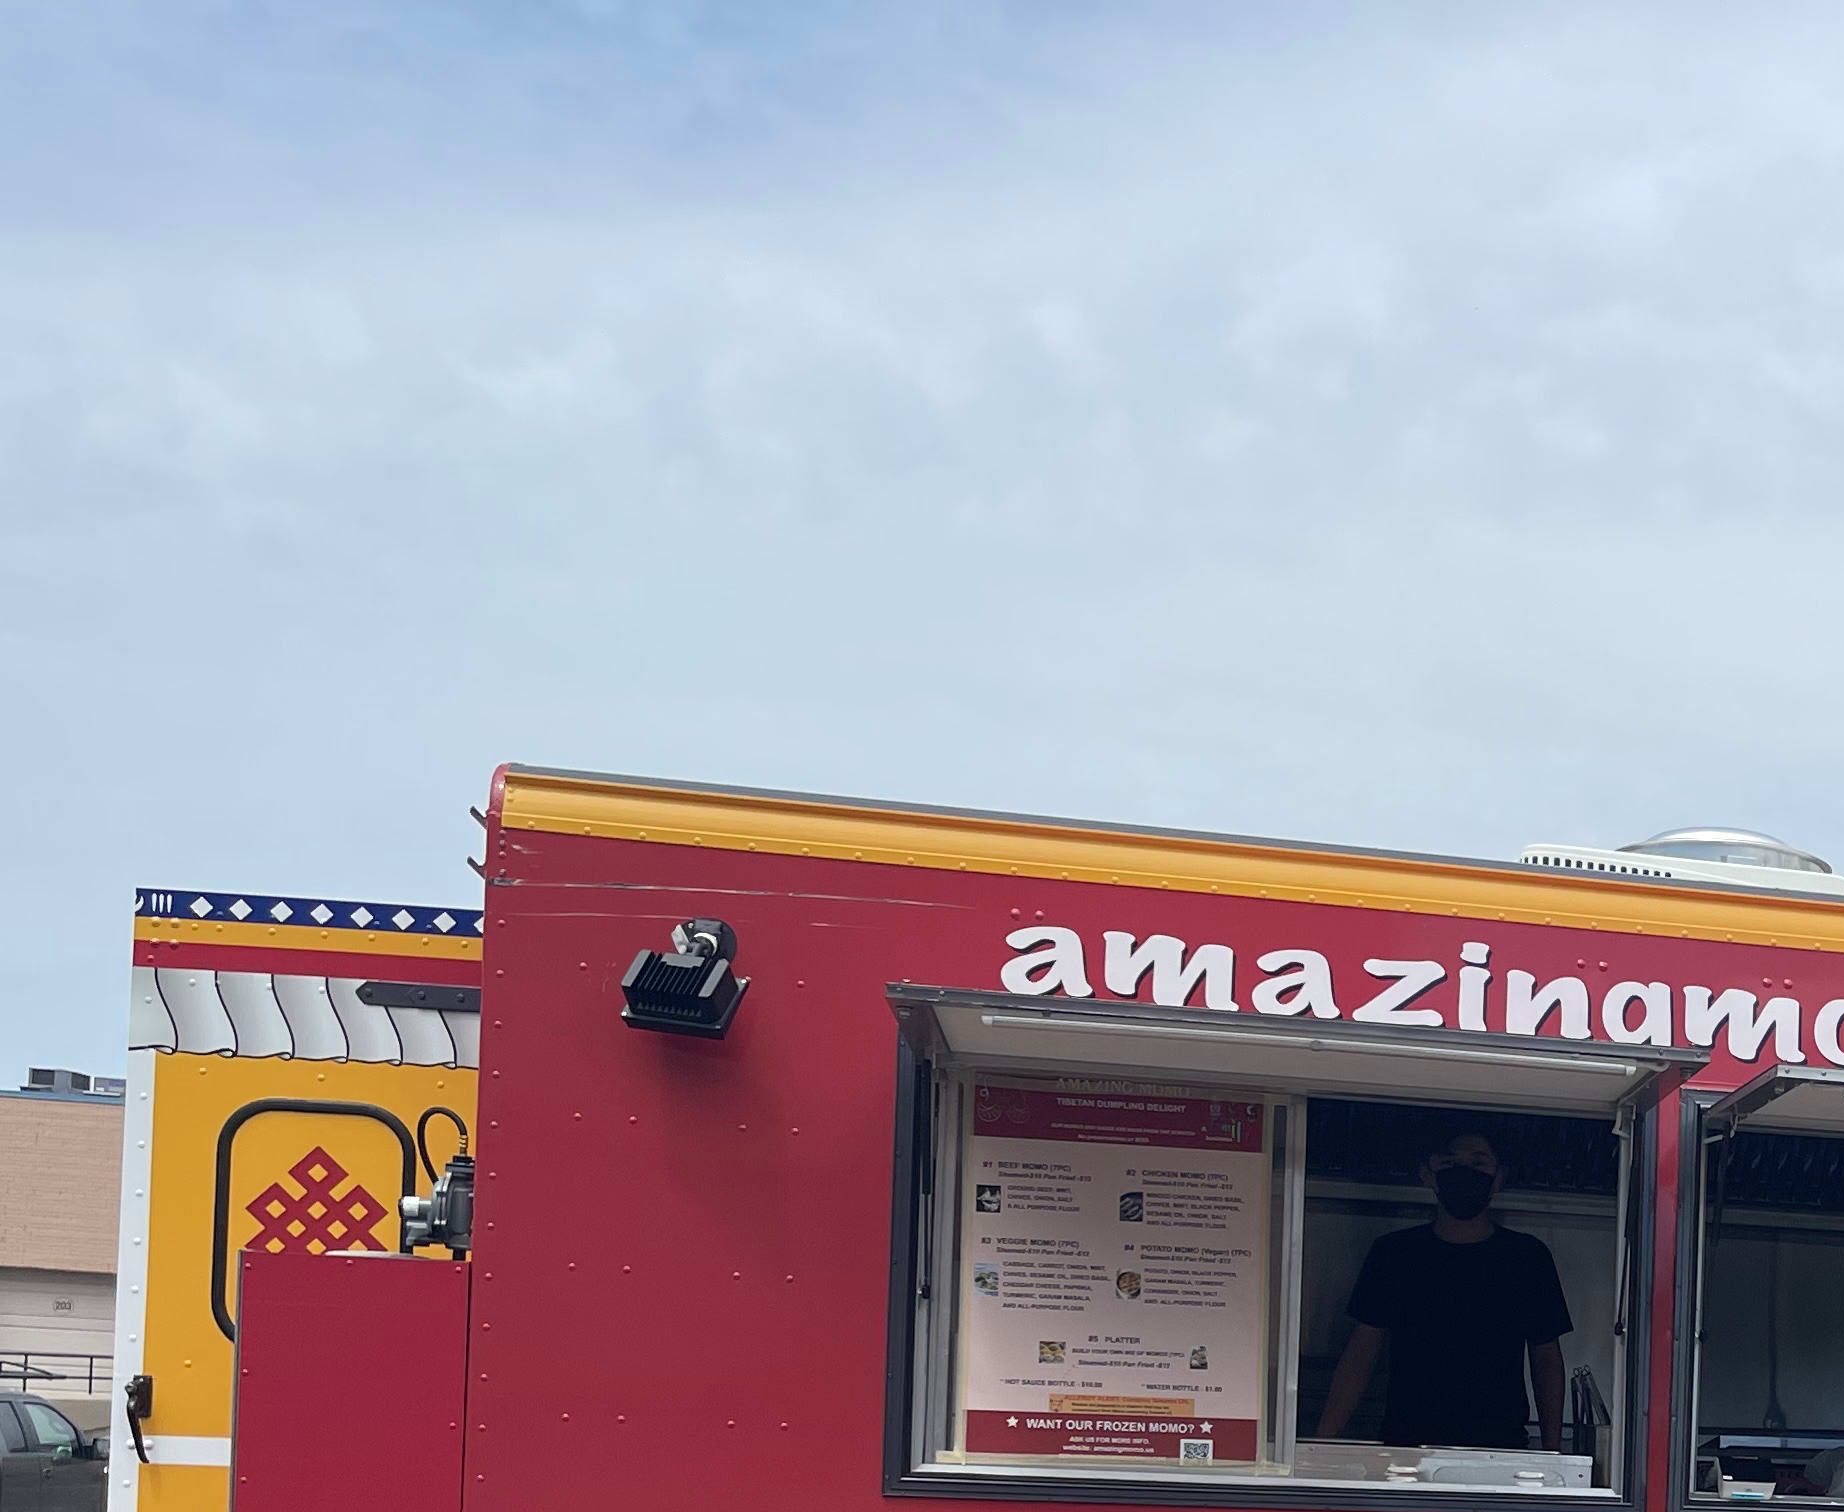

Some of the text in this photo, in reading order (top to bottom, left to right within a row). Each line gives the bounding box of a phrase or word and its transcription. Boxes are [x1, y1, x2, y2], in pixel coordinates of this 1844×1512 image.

[1057, 1097, 1186, 1113] TIBETAN DUMPLING DELIGHT
[1022, 1162, 1048, 1170] MOMO
[1142, 1170, 1178, 1178] CHICKEN
[1180, 1172, 1205, 1180] MOMO
[1030, 1239, 1056, 1247] MOMO
[1105, 1336, 1140, 1345] PLATTER
[1026, 1418, 1195, 1434] WANT OUR FROZEN MOMO?
